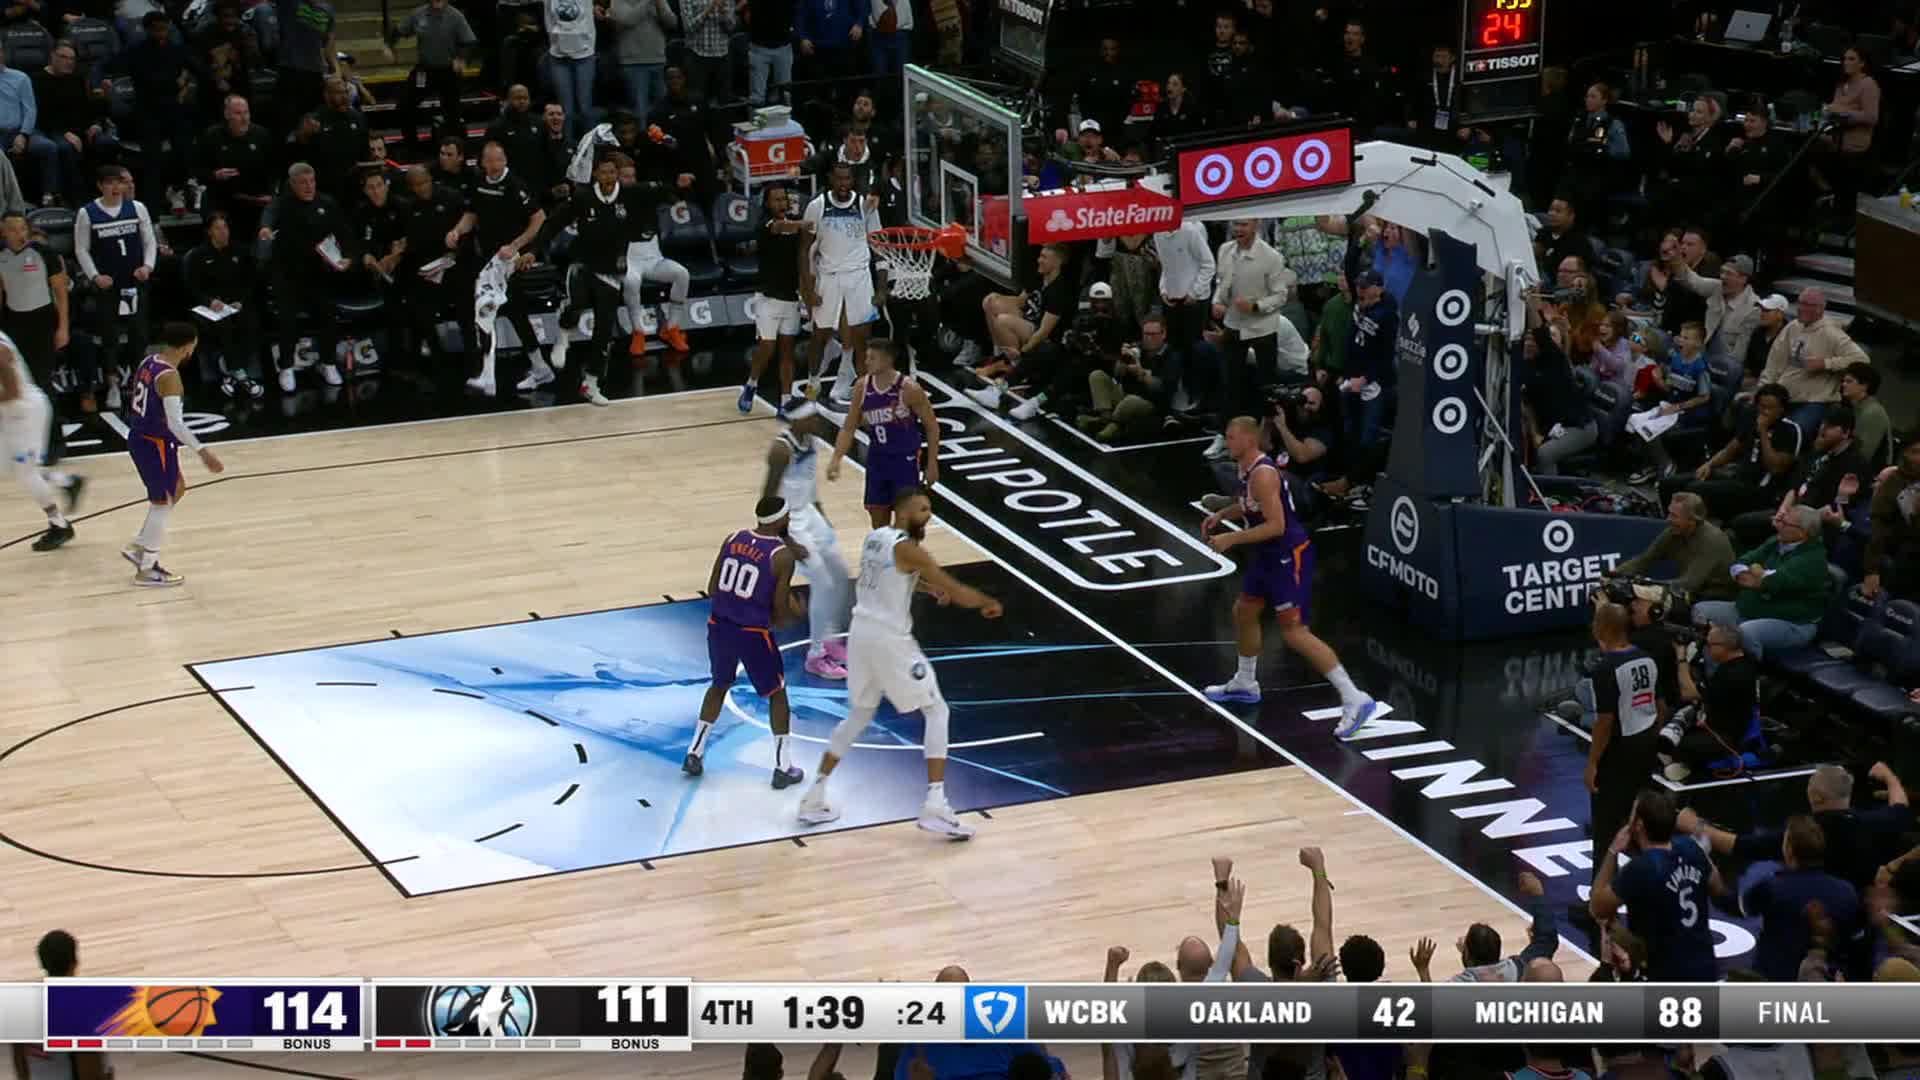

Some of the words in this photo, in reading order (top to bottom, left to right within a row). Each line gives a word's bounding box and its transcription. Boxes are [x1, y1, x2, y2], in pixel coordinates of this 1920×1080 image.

[1483, 13, 1520, 45] 24
[1487, 53, 1539, 70] TISSOT
[768, 143, 786, 164] G
[670, 201, 691, 224] G
[728, 199, 749, 222] G
[117, 239, 128, 256] 1
[690, 302, 713, 325] G
[718, 557, 760, 599] 00
[1367, 544, 1439, 600] CFMOTO
[1502, 552, 1622, 589] TARGET
[1631, 664, 1650, 692] 38
[1679, 886, 1699, 928] 5
